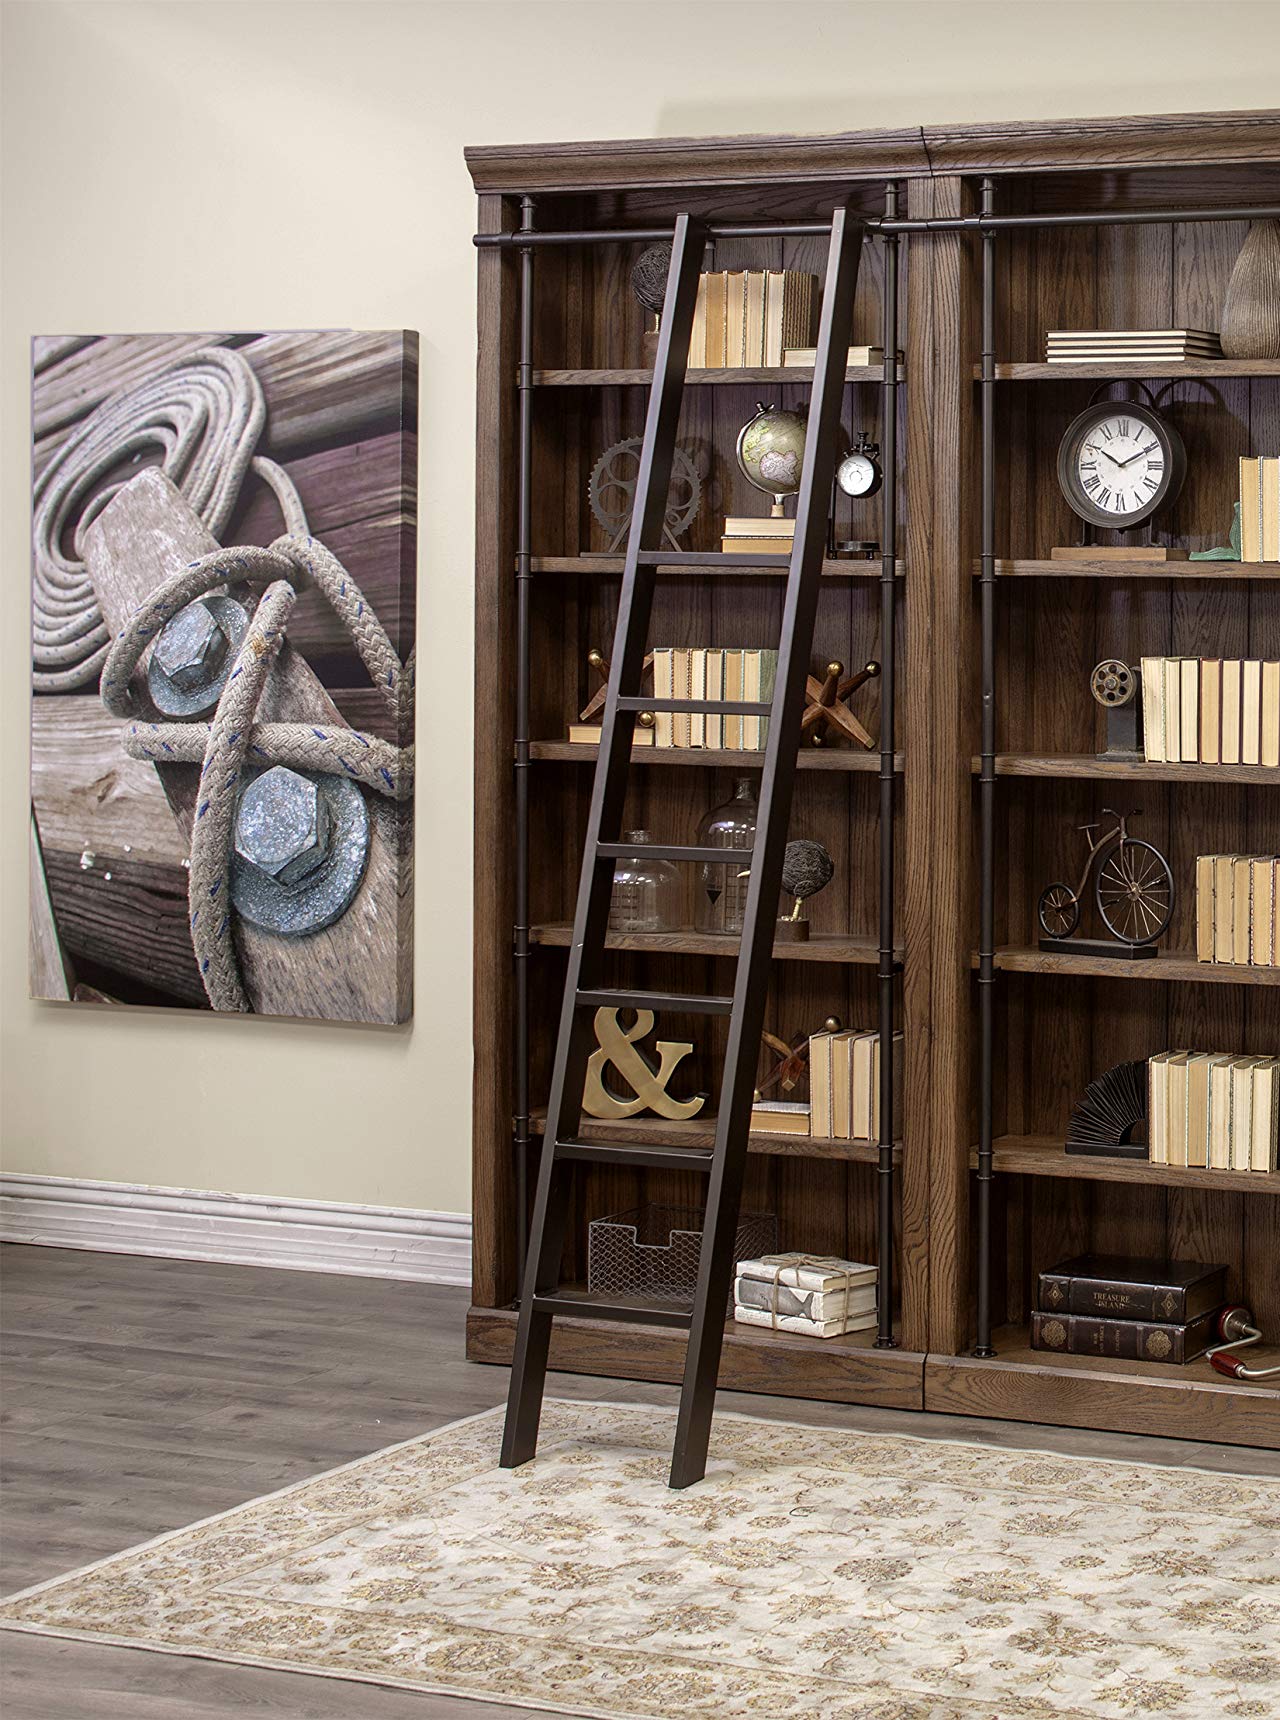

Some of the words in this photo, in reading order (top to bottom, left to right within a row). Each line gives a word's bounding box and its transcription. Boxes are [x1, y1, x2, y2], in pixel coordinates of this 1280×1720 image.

[1099, 423, 1114, 443] XI
[1116, 419, 1130, 437] XII
[1133, 425, 1145, 443] I
[1147, 460, 1164, 472] III
[1096, 486, 1112, 508] VII
[1115, 492, 1127, 511] VI
[1133, 490, 1146, 508] V
[582, 1006, 706, 1121] &
[1093, 1292, 1130, 1303] TREASURE
[1098, 1300, 1127, 1309] ISLAND
